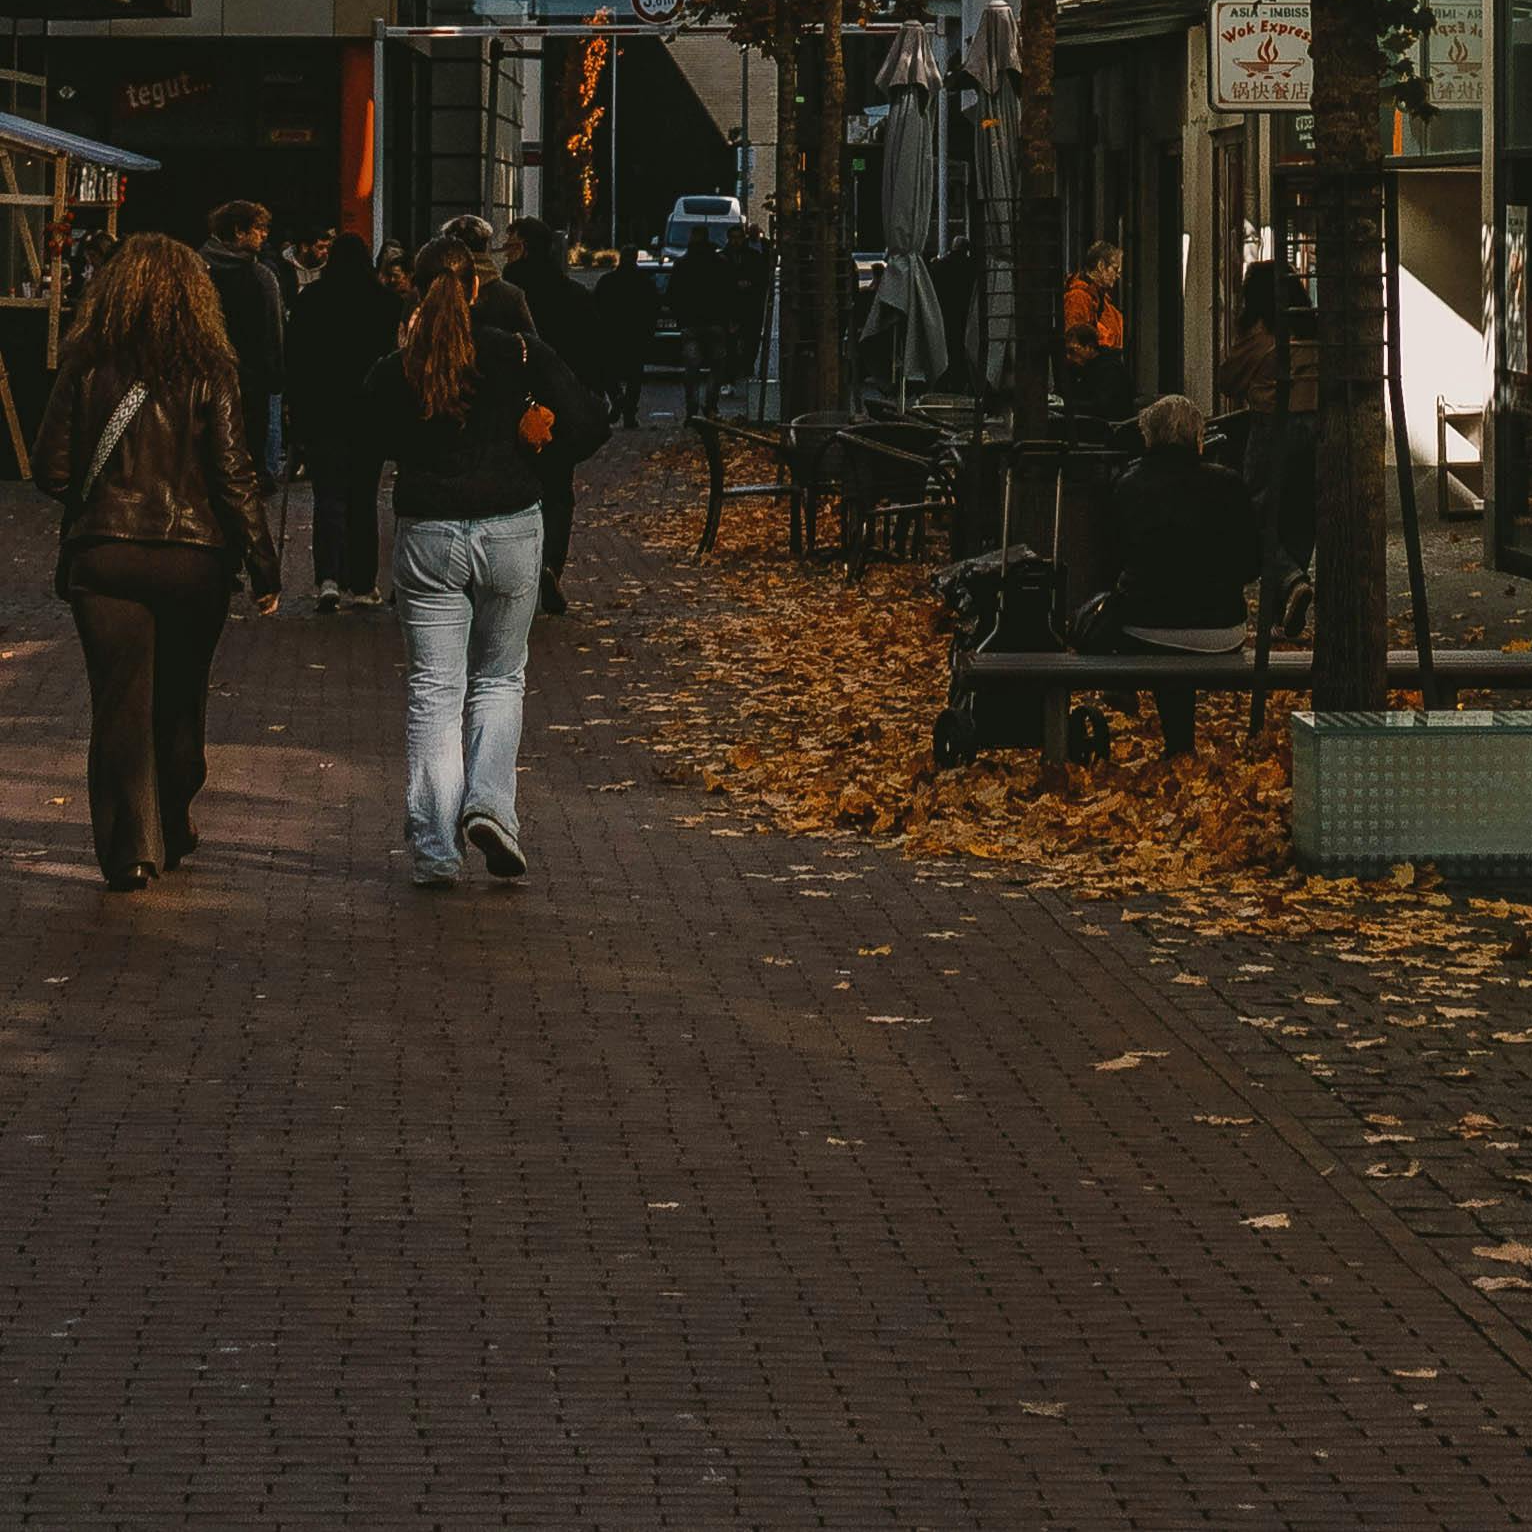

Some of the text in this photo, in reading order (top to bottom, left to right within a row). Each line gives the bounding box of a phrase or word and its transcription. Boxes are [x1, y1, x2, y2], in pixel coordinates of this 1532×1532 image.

[1229, 7, 1259, 18] ASIA
[1270, 7, 1310, 19] IMBISS
[1220, 21, 1256, 44] Wok
